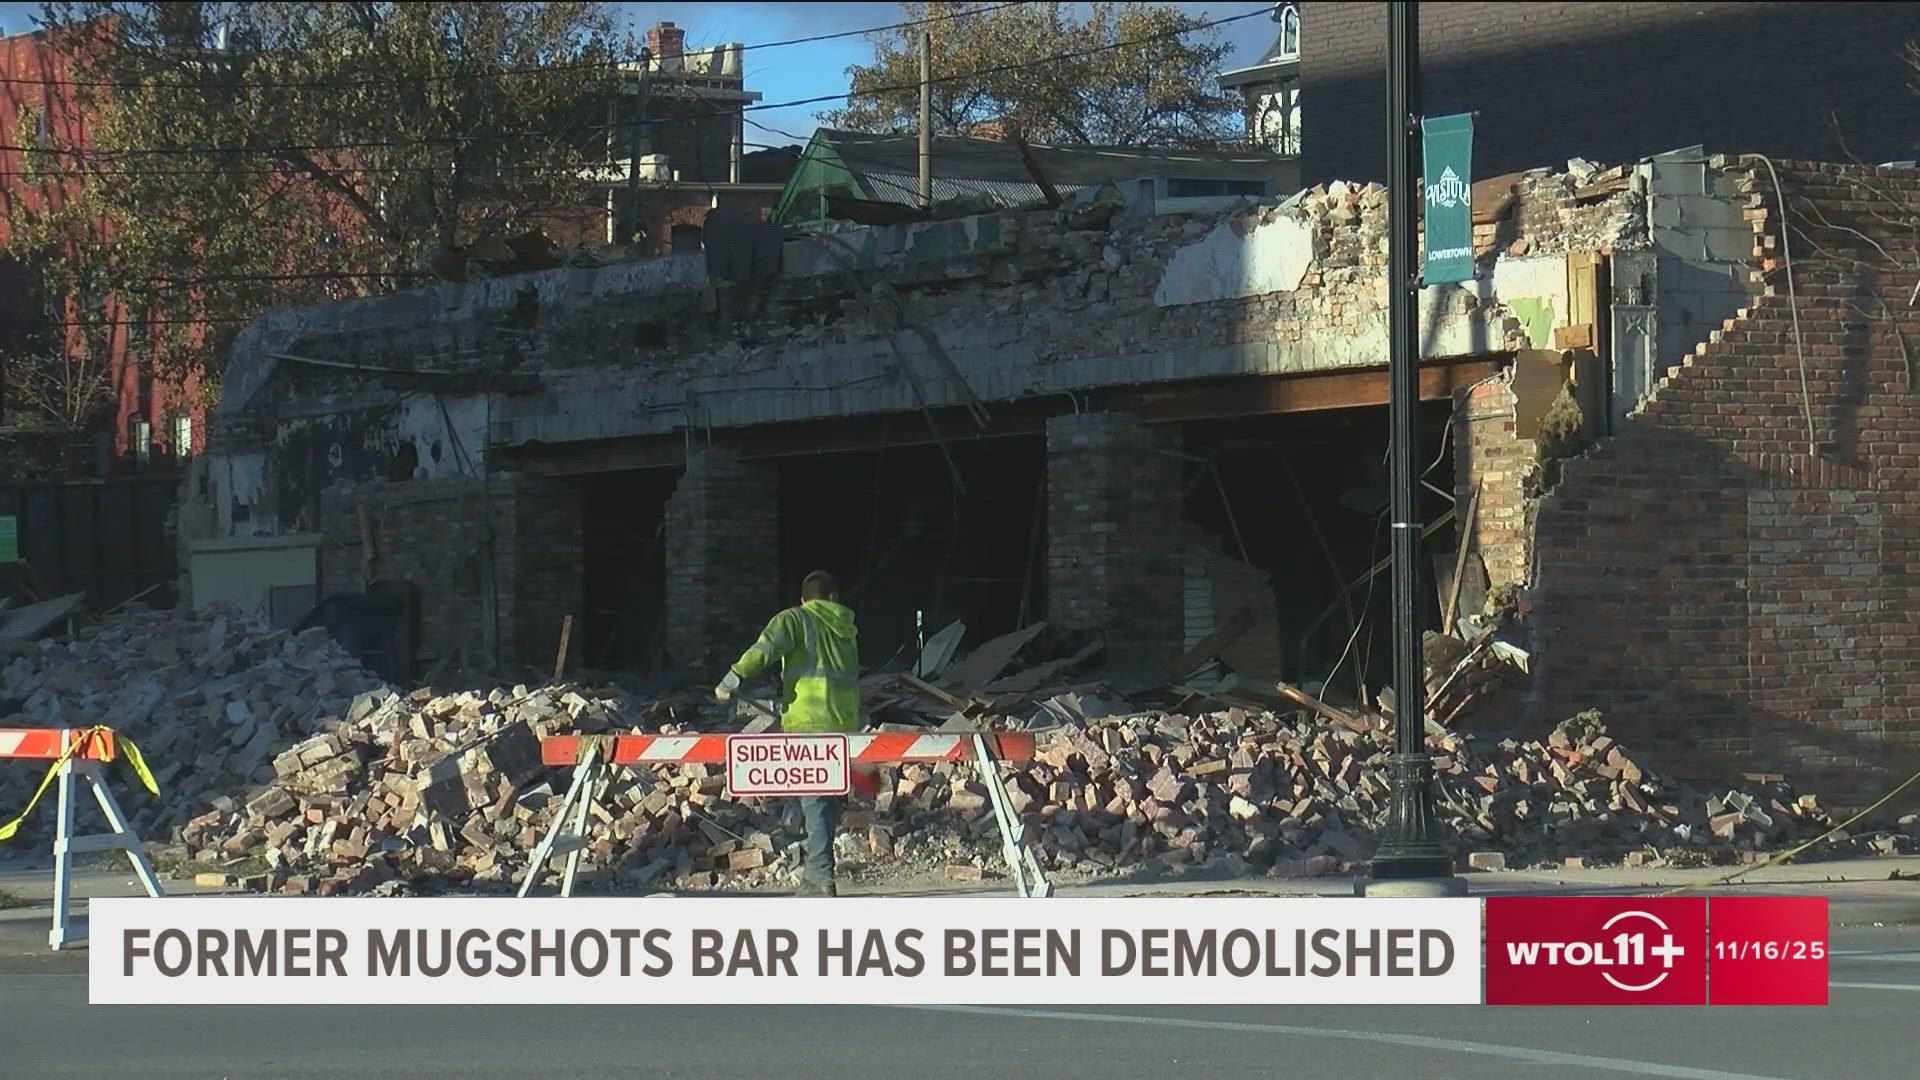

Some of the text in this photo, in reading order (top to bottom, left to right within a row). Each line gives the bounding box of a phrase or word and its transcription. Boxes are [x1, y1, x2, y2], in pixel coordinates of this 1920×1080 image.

[1425, 175, 1471, 207] VISTULA
[1428, 247, 1472, 261] LOWERTOWN
[736, 744, 839, 762] SIDEWALK
[748, 767, 829, 785] CLOSED
